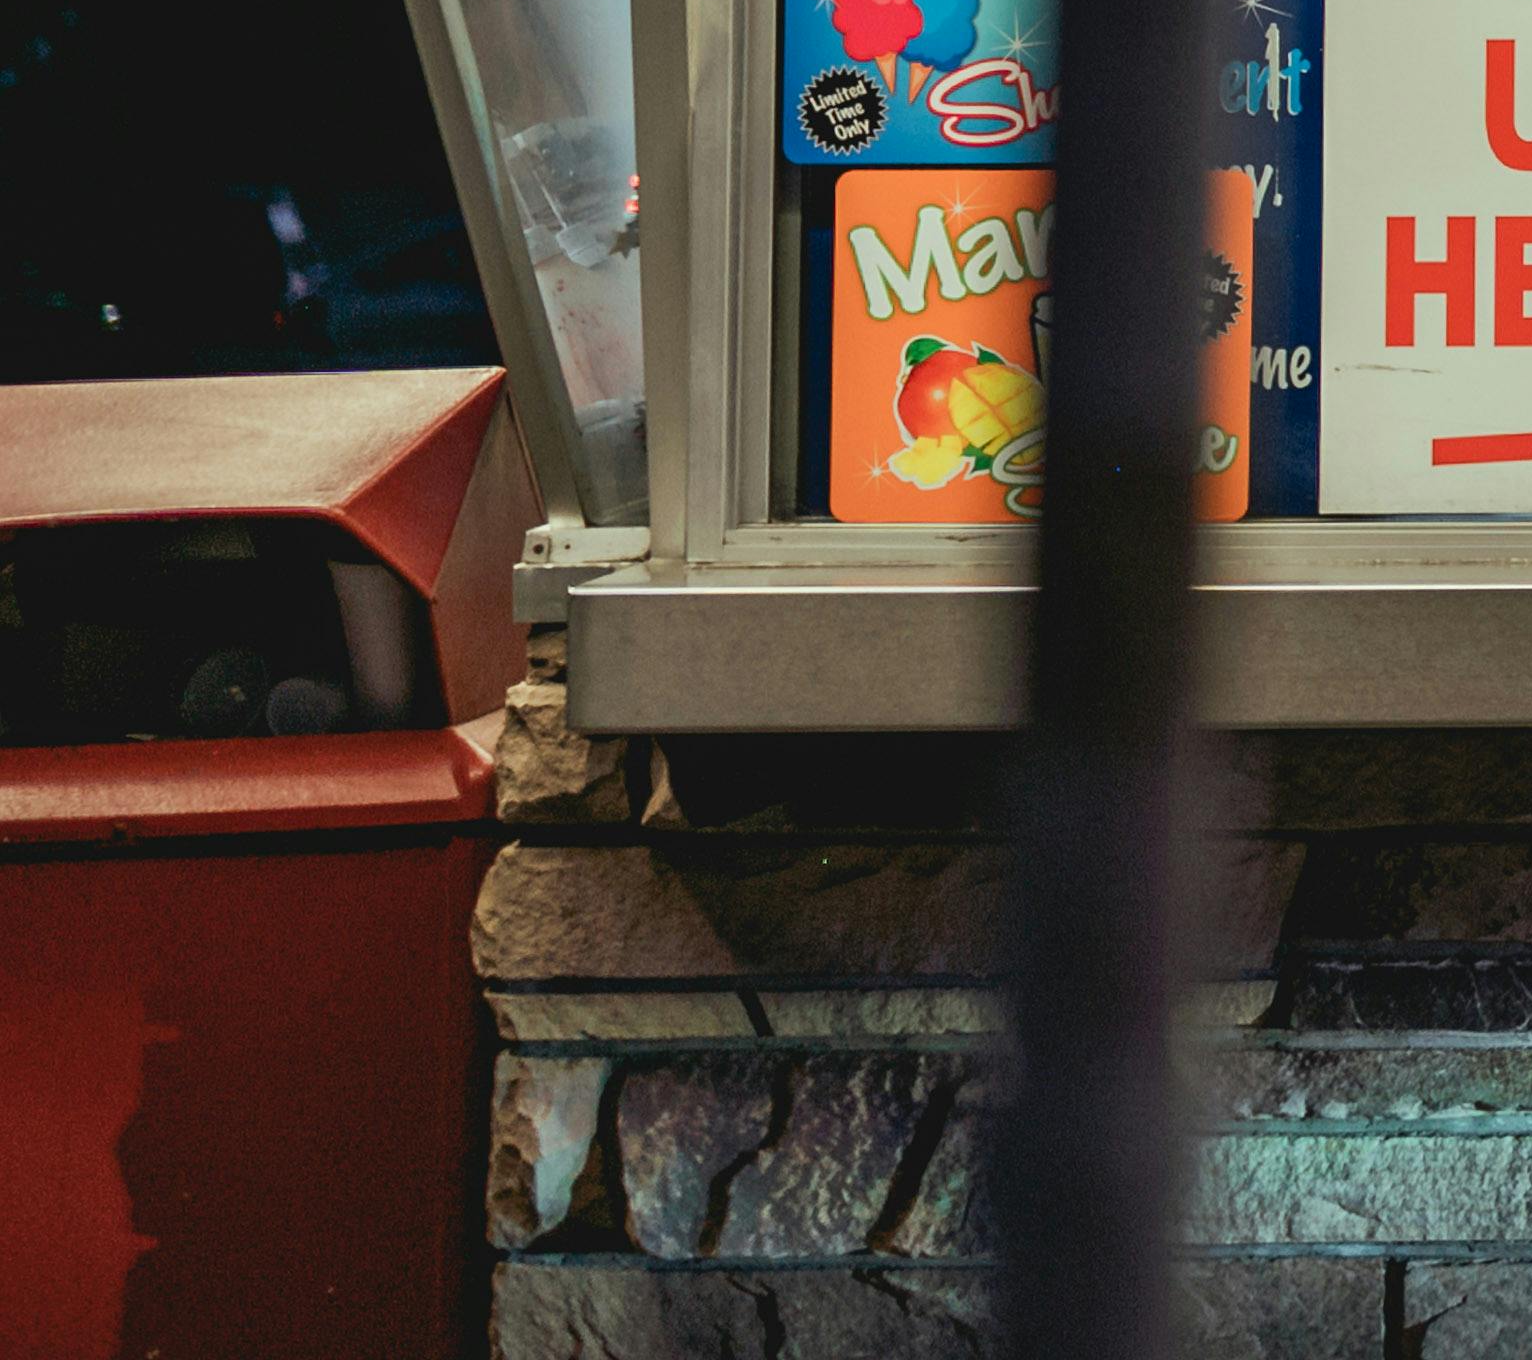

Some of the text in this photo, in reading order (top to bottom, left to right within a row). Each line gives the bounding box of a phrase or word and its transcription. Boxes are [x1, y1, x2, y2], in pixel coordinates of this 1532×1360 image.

[811, 80, 868, 115] Limited
[824, 101, 866, 126] Time
[833, 121, 871, 141] Only
